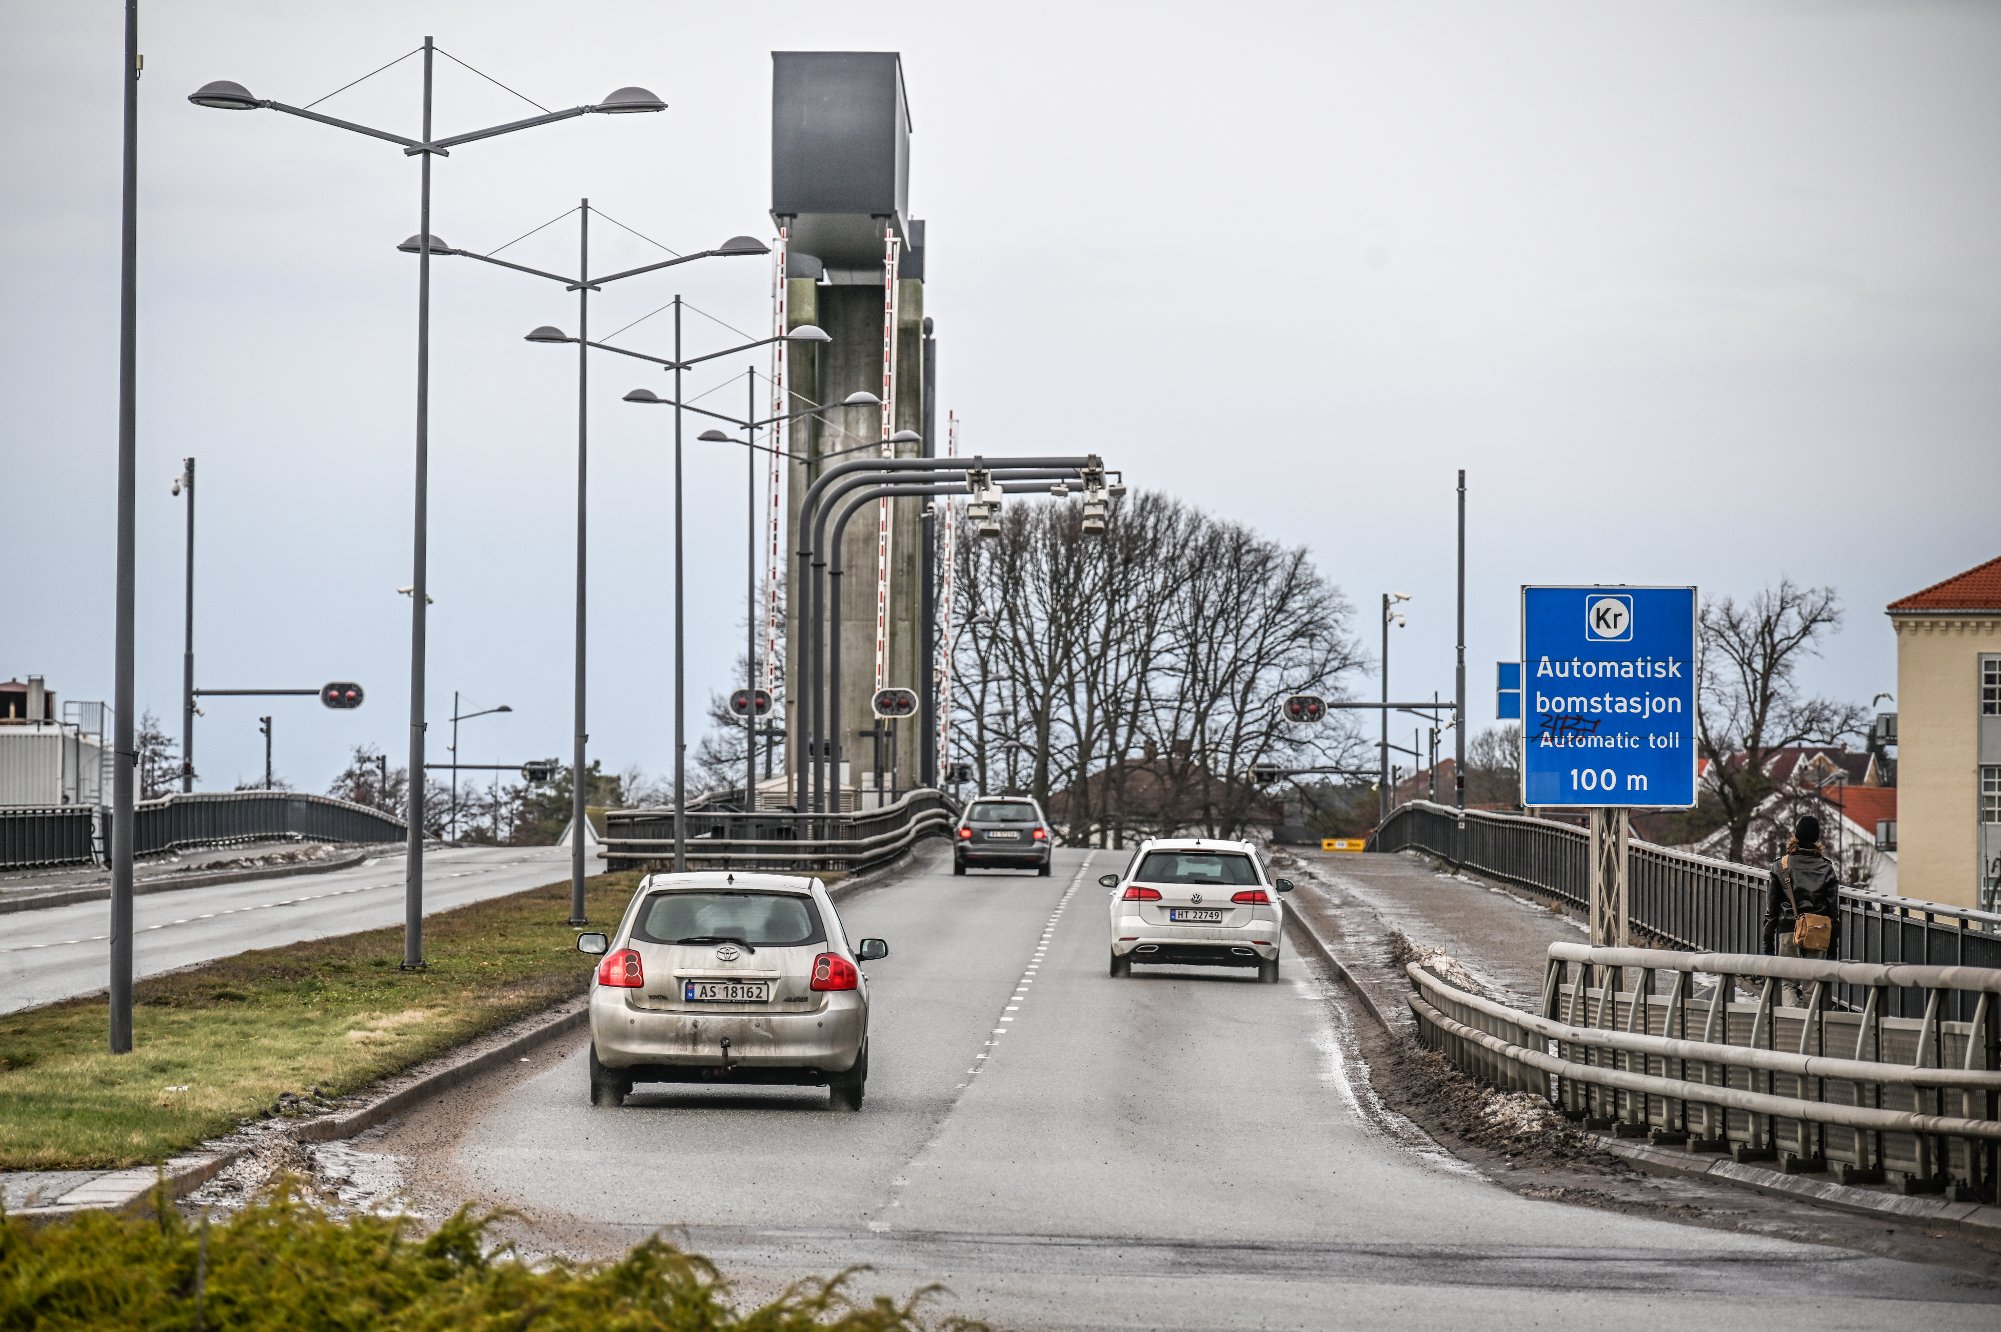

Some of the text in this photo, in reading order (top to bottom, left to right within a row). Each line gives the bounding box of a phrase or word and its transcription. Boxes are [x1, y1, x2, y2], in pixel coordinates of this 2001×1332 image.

[1596, 607, 1623, 629] Kr
[1536, 655, 1682, 678] Automatisk
[1536, 691, 1682, 719] bomstasjon
[1540, 731, 1680, 748] Automatic toll
[1570, 768, 1648, 791] 100 m
[1177, 910, 1220, 920] HT 22749
[700, 985, 763, 999] AS 18162
